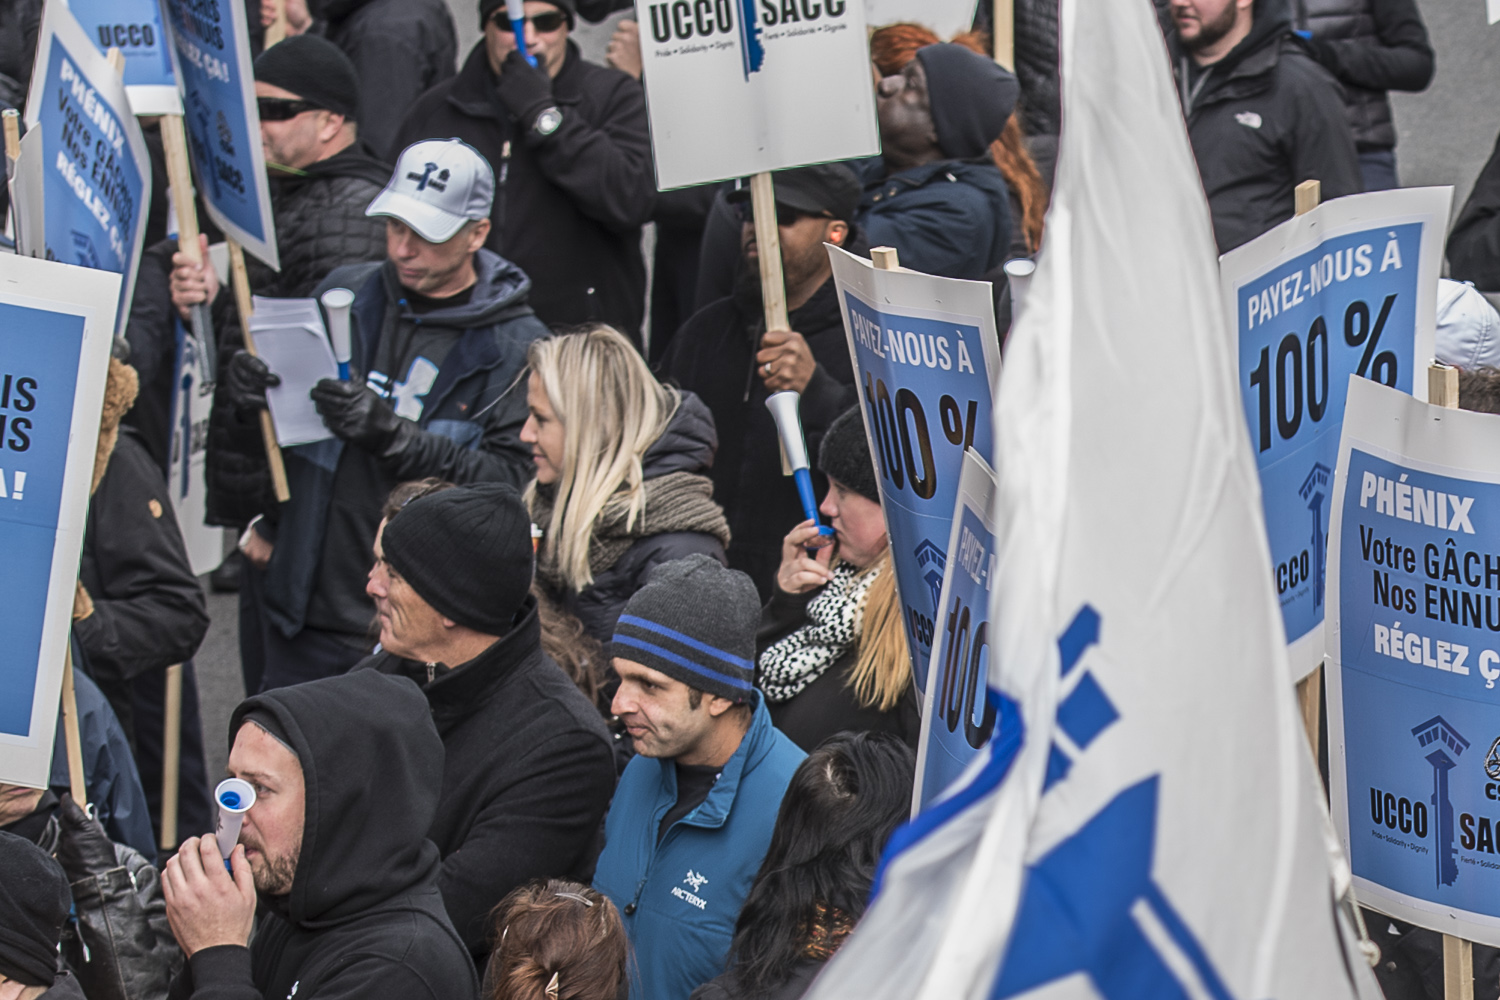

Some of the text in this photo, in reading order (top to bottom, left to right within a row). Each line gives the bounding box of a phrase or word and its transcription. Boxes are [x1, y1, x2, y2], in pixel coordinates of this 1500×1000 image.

[98, 24, 155, 47] UCCO
[649, 0, 733, 43] UCCO
[58, 87, 92, 147] Votre
[60, 57, 125, 158] PHÉNIX
[62, 121, 88, 170] Nos
[57, 151, 111, 231] RÉGLEZ
[1248, 231, 1402, 331] PAYEZ-NOUS À
[851, 308, 975, 374] PAYEZ-NOUS À
[1250, 314, 1329, 454] 100
[865, 371, 937, 499] 100
[1360, 471, 1475, 535] PHÉNIX
[1273, 549, 1309, 595] CCO
[1359, 524, 1416, 573] Votre
[1373, 570, 1417, 614] Nos
[939, 596, 998, 750] 100
[1374, 621, 1469, 676] RÉGLEZ
[1370, 787, 1428, 838] UCCO
